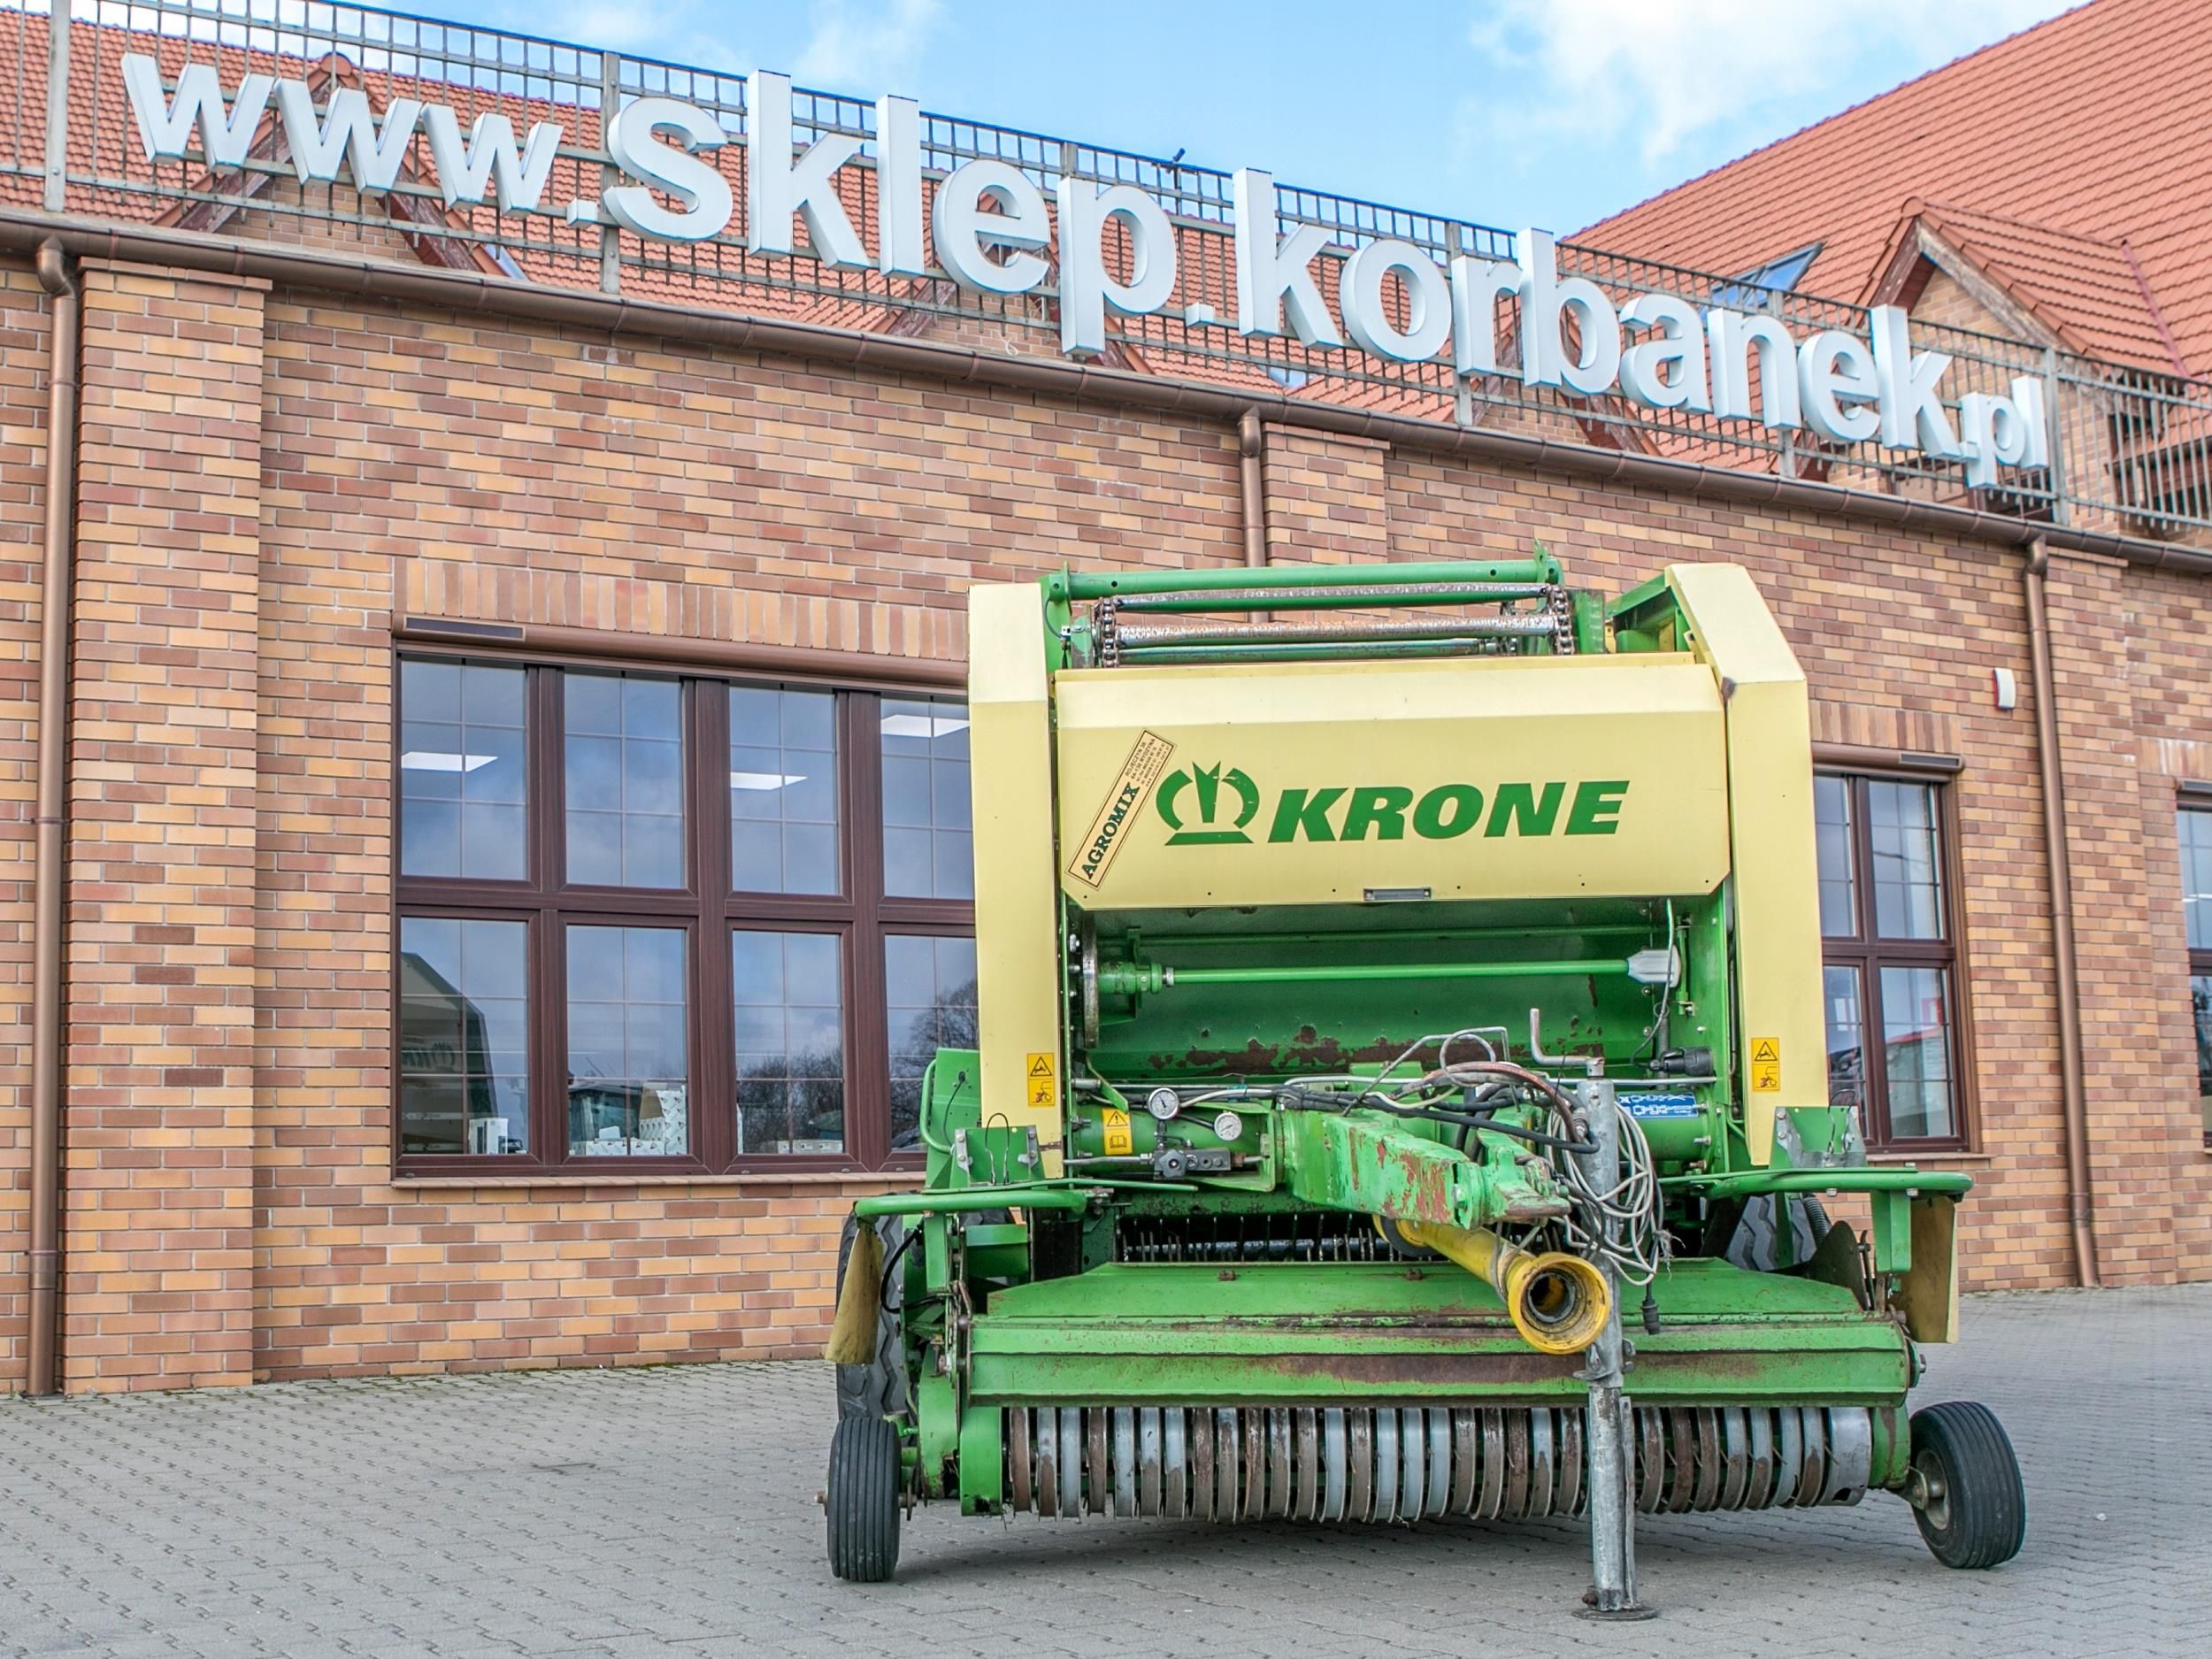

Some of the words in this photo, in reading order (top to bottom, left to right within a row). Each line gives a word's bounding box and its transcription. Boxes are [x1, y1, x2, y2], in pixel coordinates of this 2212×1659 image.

[121, 51, 2049, 489] www.sklep.korbanek.pl
[1081, 781, 1140, 879] AGROMIX
[1267, 780, 1631, 844] KRONE
